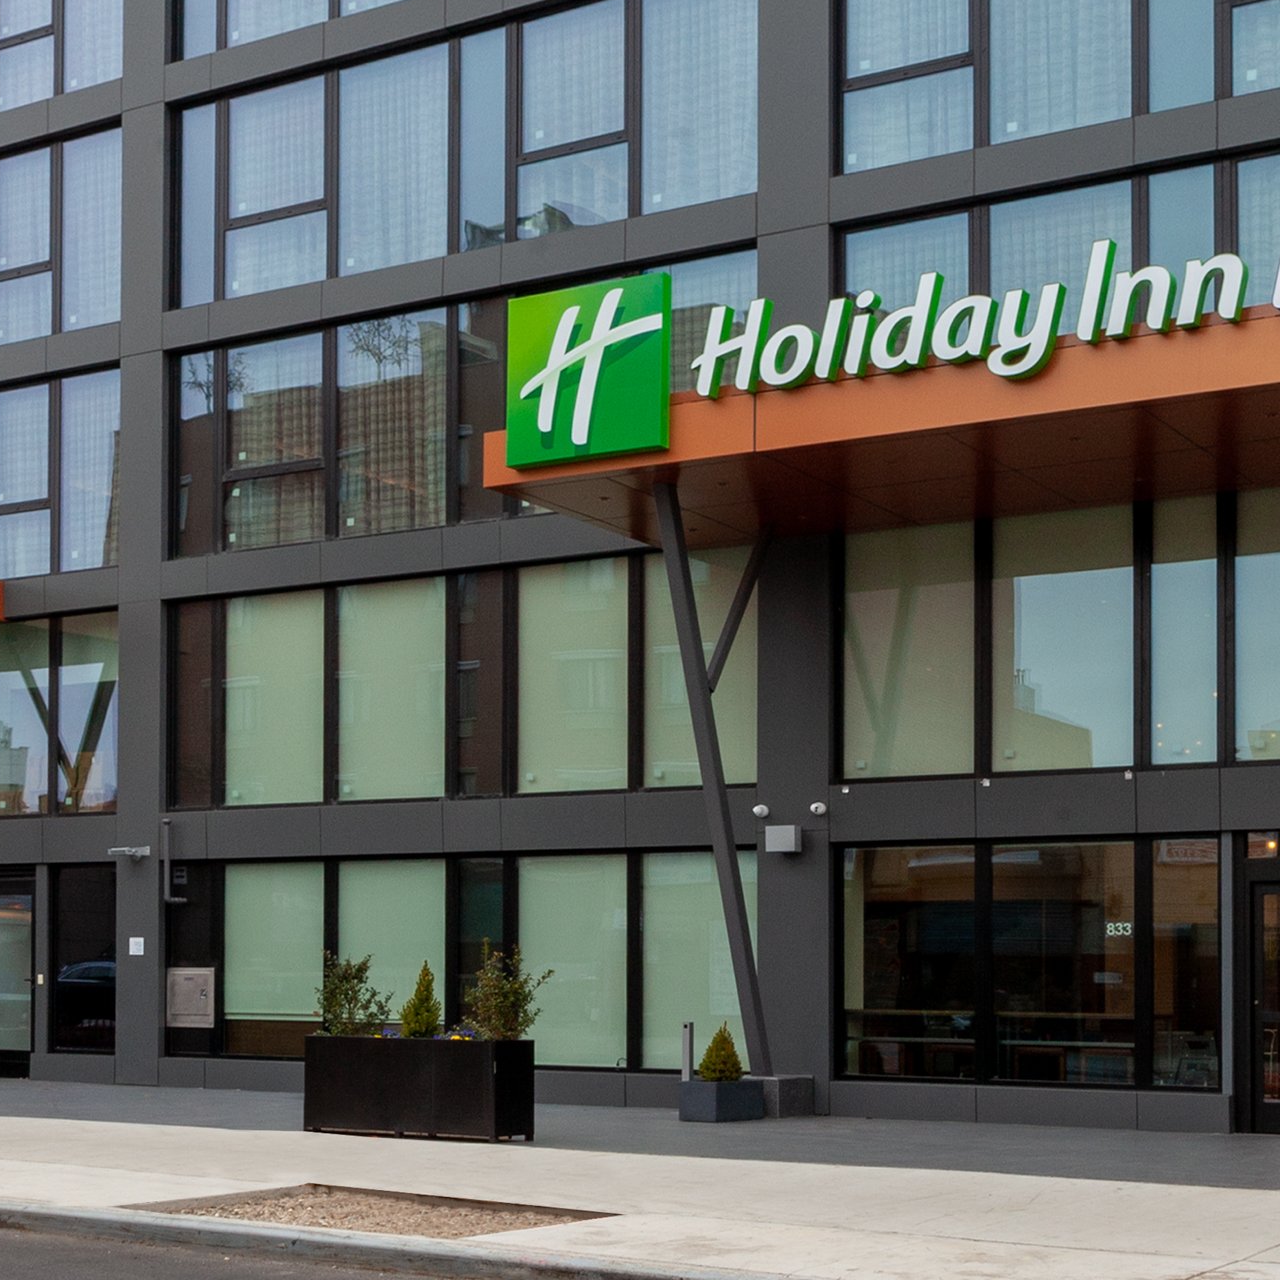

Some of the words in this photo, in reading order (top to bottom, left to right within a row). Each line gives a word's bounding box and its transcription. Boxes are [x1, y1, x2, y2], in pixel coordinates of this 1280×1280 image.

[691, 271, 1067, 400] Holiday
[1076, 238, 1248, 344] Inn
[1106, 922, 1132, 936] 833
